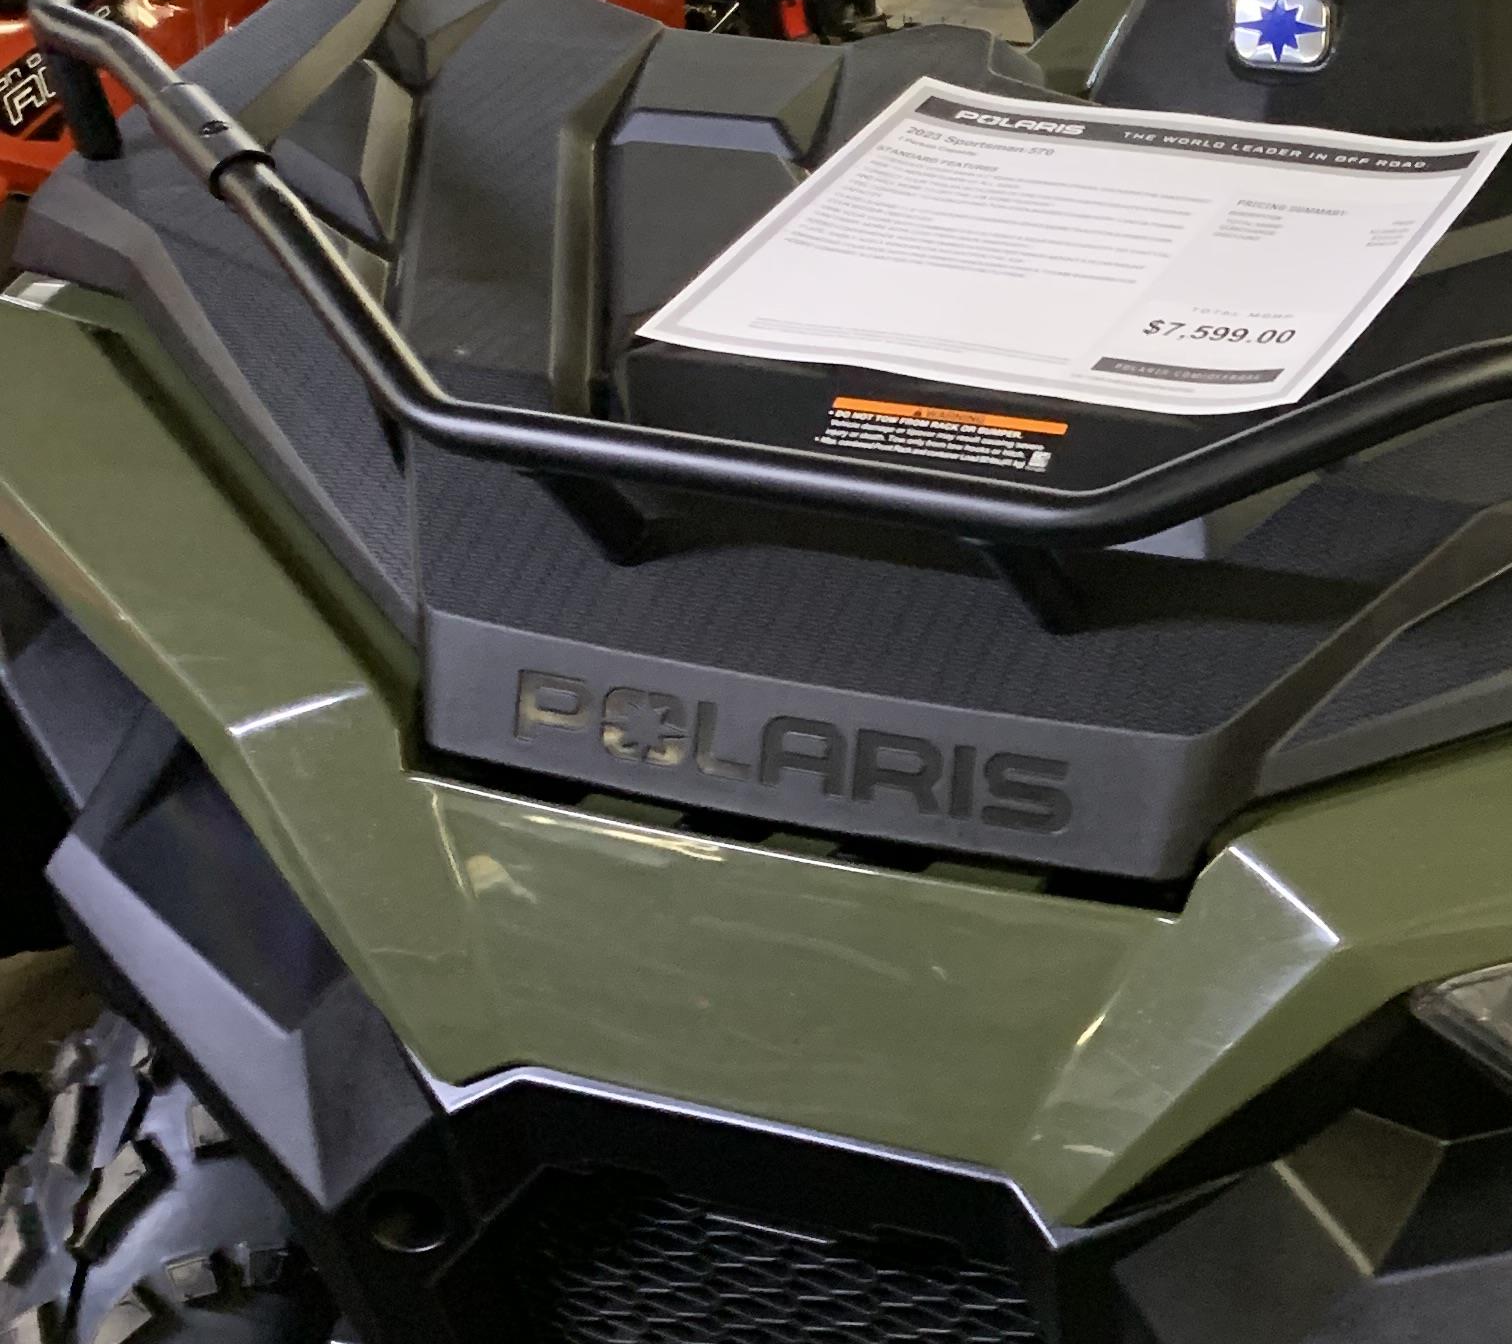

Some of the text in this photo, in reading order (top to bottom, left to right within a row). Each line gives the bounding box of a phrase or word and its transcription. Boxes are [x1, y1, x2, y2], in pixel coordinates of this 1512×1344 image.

[954, 110, 1087, 136] POLARIS
[905, 126, 1055, 157] 2023 Sportsman 570
[1122, 130, 1157, 142] THE
[1163, 134, 1225, 150] WORLD
[1231, 143, 1303, 158] LEADER
[1308, 151, 1328, 162] IN
[1334, 154, 1370, 166] OFF
[1142, 318, 1297, 345] $7,599.00
[513, 667, 1073, 836] POLARIS
